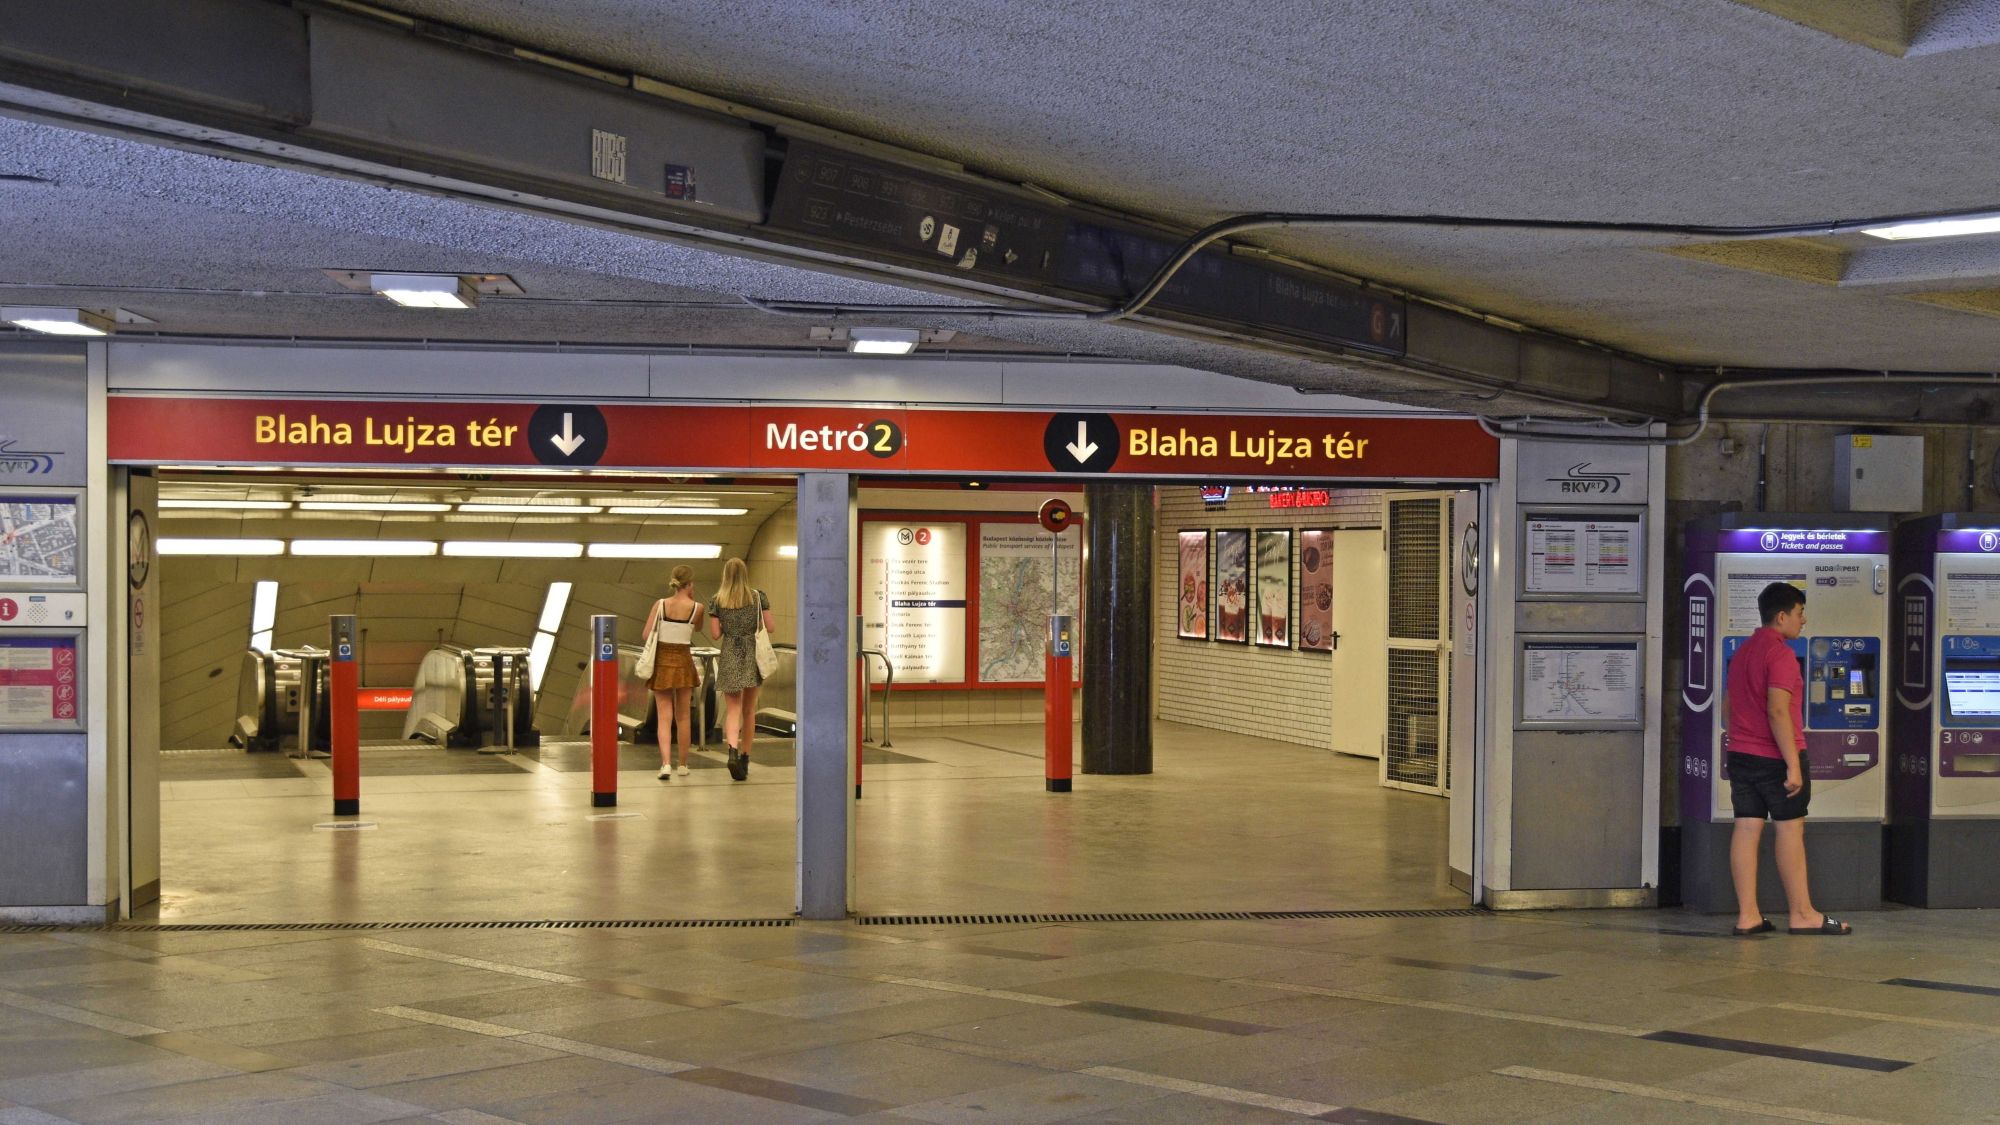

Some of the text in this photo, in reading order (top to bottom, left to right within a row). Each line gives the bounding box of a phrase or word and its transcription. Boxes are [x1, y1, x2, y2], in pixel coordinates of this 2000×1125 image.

[256, 415, 518, 453] Blaha Lujza tér
[766, 423, 892, 451] Metró 2
[1129, 428, 1369, 465] Blaha Lujza tér
[919, 532, 927, 542] 2
[1781, 532, 1846, 541] Jegyek és bérletek
[1820, 543, 1843, 551] passes
[1729, 640, 1736, 651] 1
[1948, 638, 1955, 649] 1
[1943, 732, 1952, 744] 3
